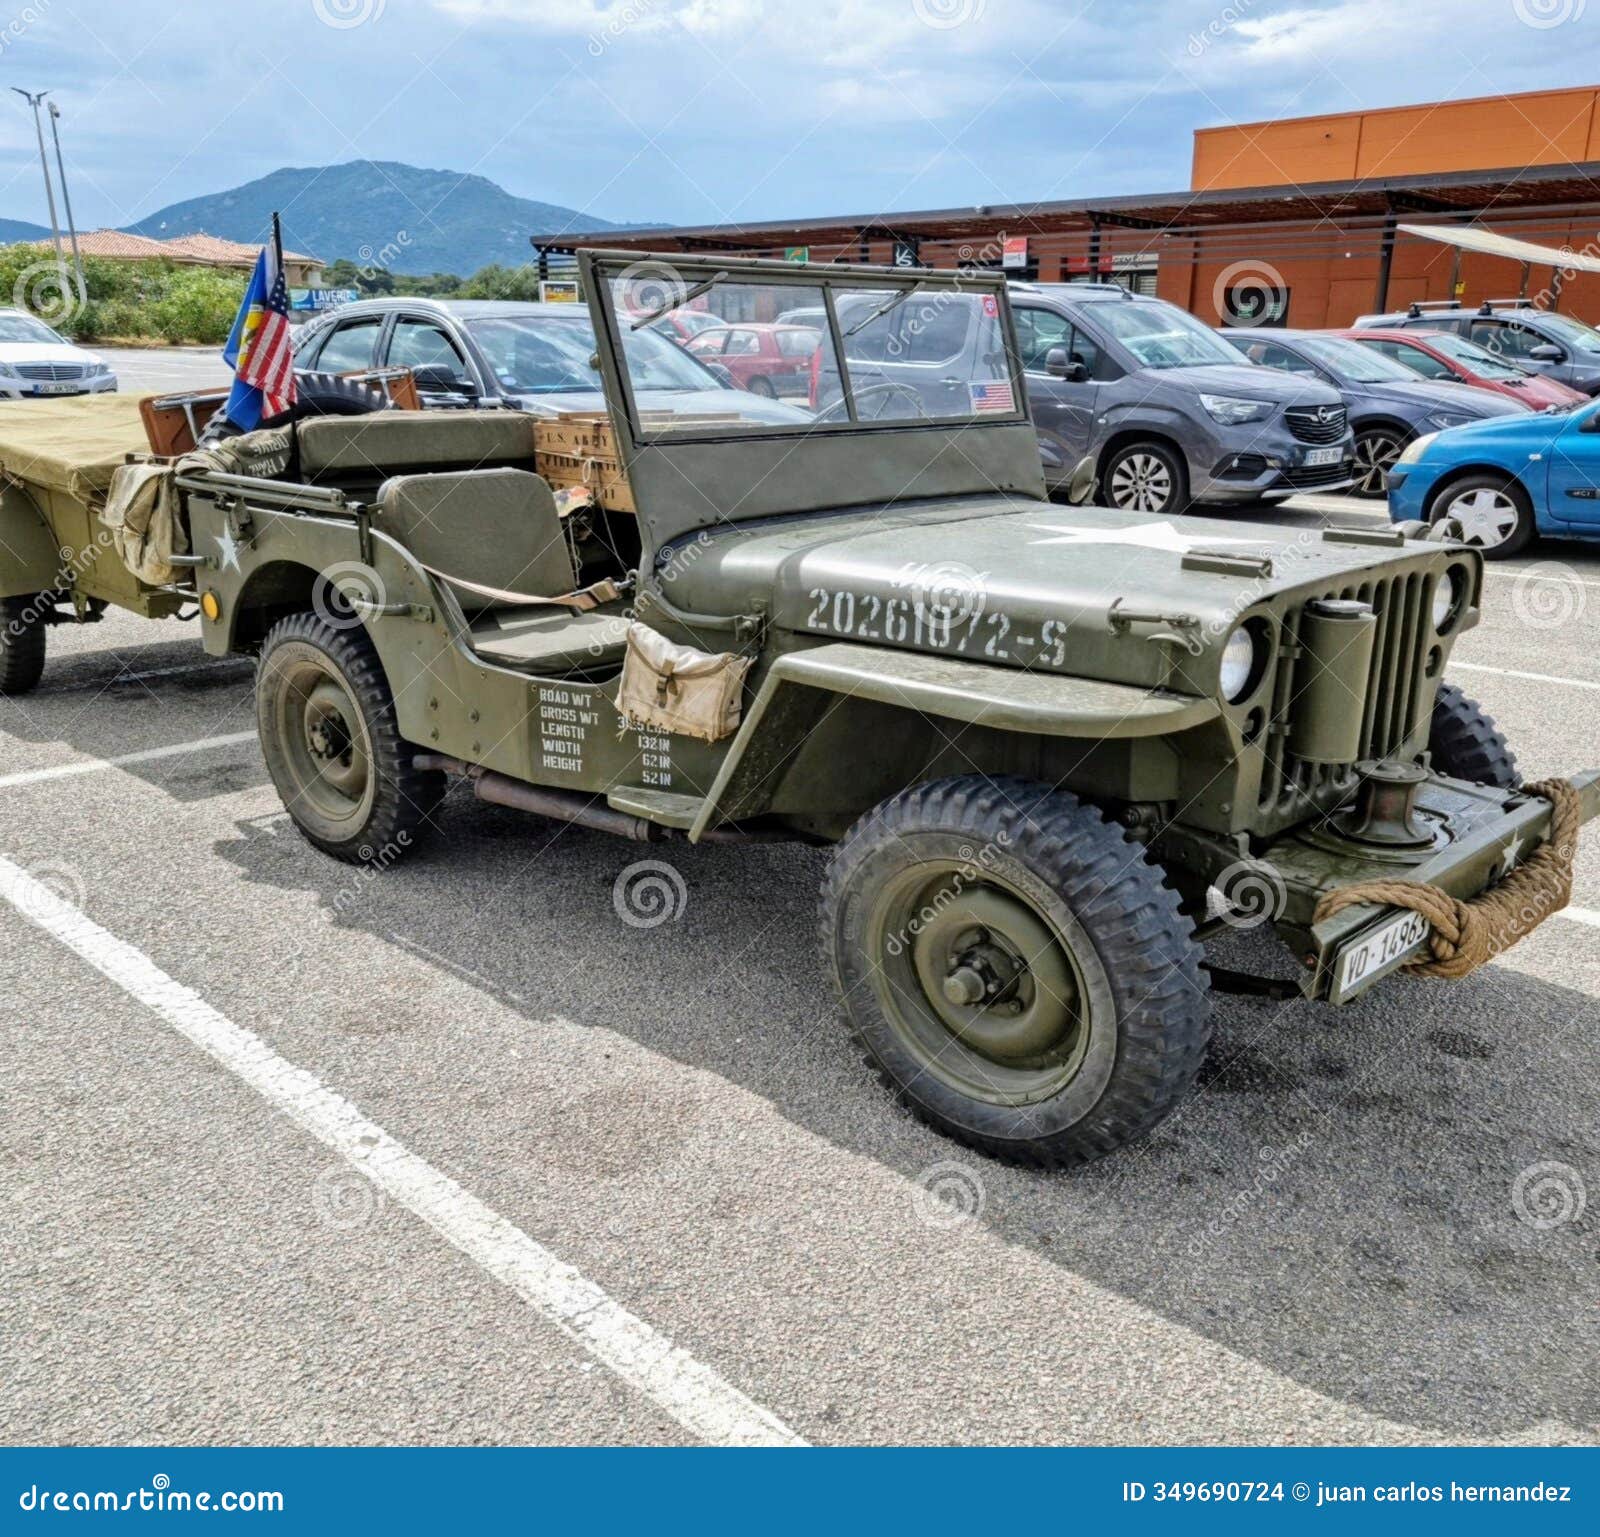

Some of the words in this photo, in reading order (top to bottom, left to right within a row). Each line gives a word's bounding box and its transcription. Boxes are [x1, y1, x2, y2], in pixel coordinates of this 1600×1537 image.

[539, 688, 569, 704] ROAD
[571, 693, 592, 708] WT
[540, 705, 577, 722] GROSS
[579, 711, 600, 726] WT
[541, 722, 585, 740] LENGTH
[542, 738, 581, 756] WIDTH
[638, 735, 658, 750] 132
[658, 738, 671, 752] IN
[542, 754, 583, 773] HEIGHT
[642, 753, 658, 768] 62
[659, 755, 671, 769] IN
[642, 770, 658, 785] 52
[659, 772, 672, 786] IN
